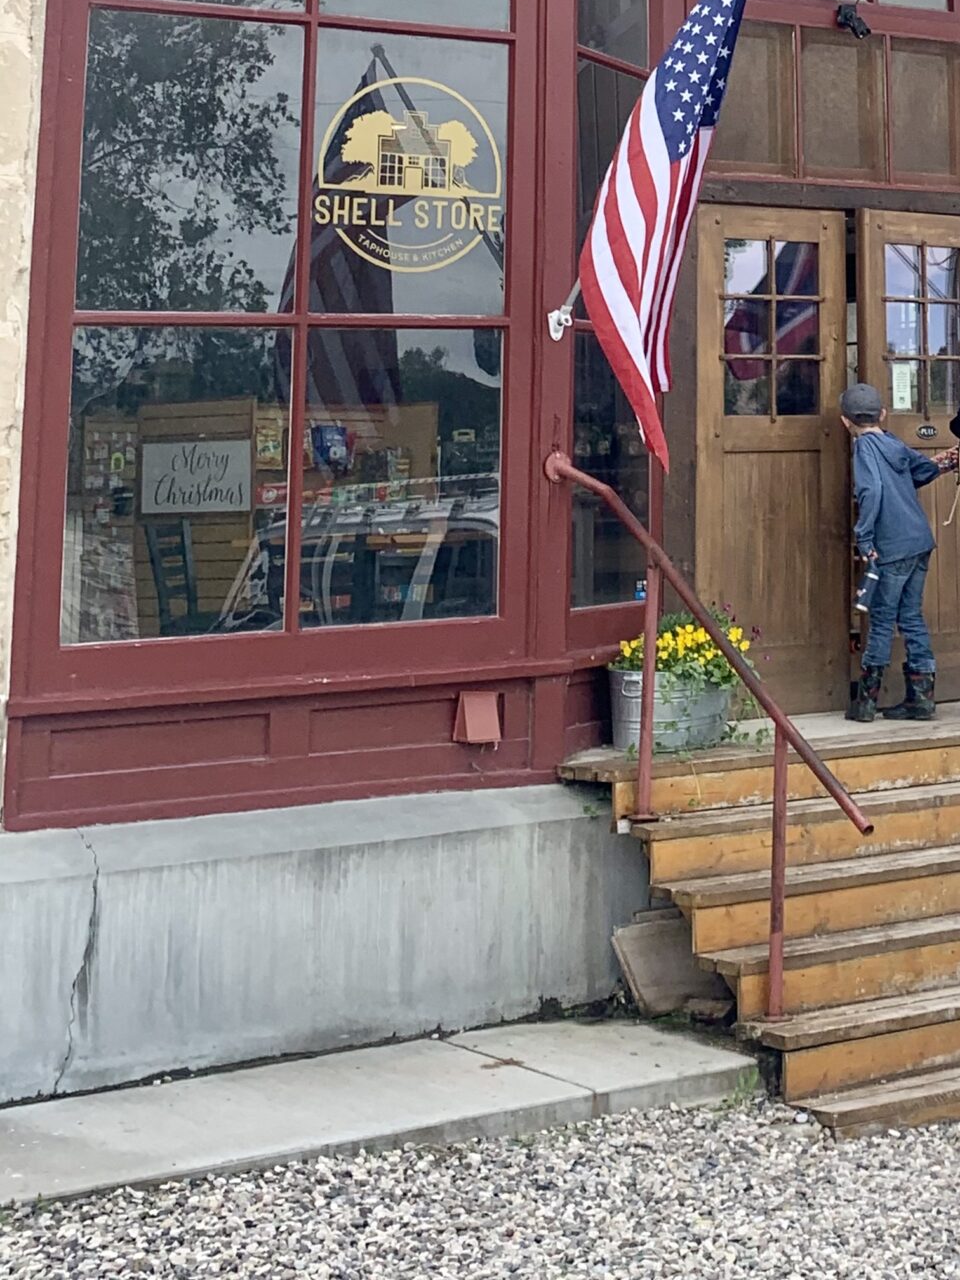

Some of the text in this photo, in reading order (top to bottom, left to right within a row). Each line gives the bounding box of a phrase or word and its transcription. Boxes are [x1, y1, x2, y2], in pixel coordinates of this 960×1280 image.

[314, 194, 501, 232] SHELL STORE
[358, 233, 463, 262] TAPHOUSE & KITCHEN
[172, 444, 229, 482] Merry
[153, 473, 242, 506] Christmas
